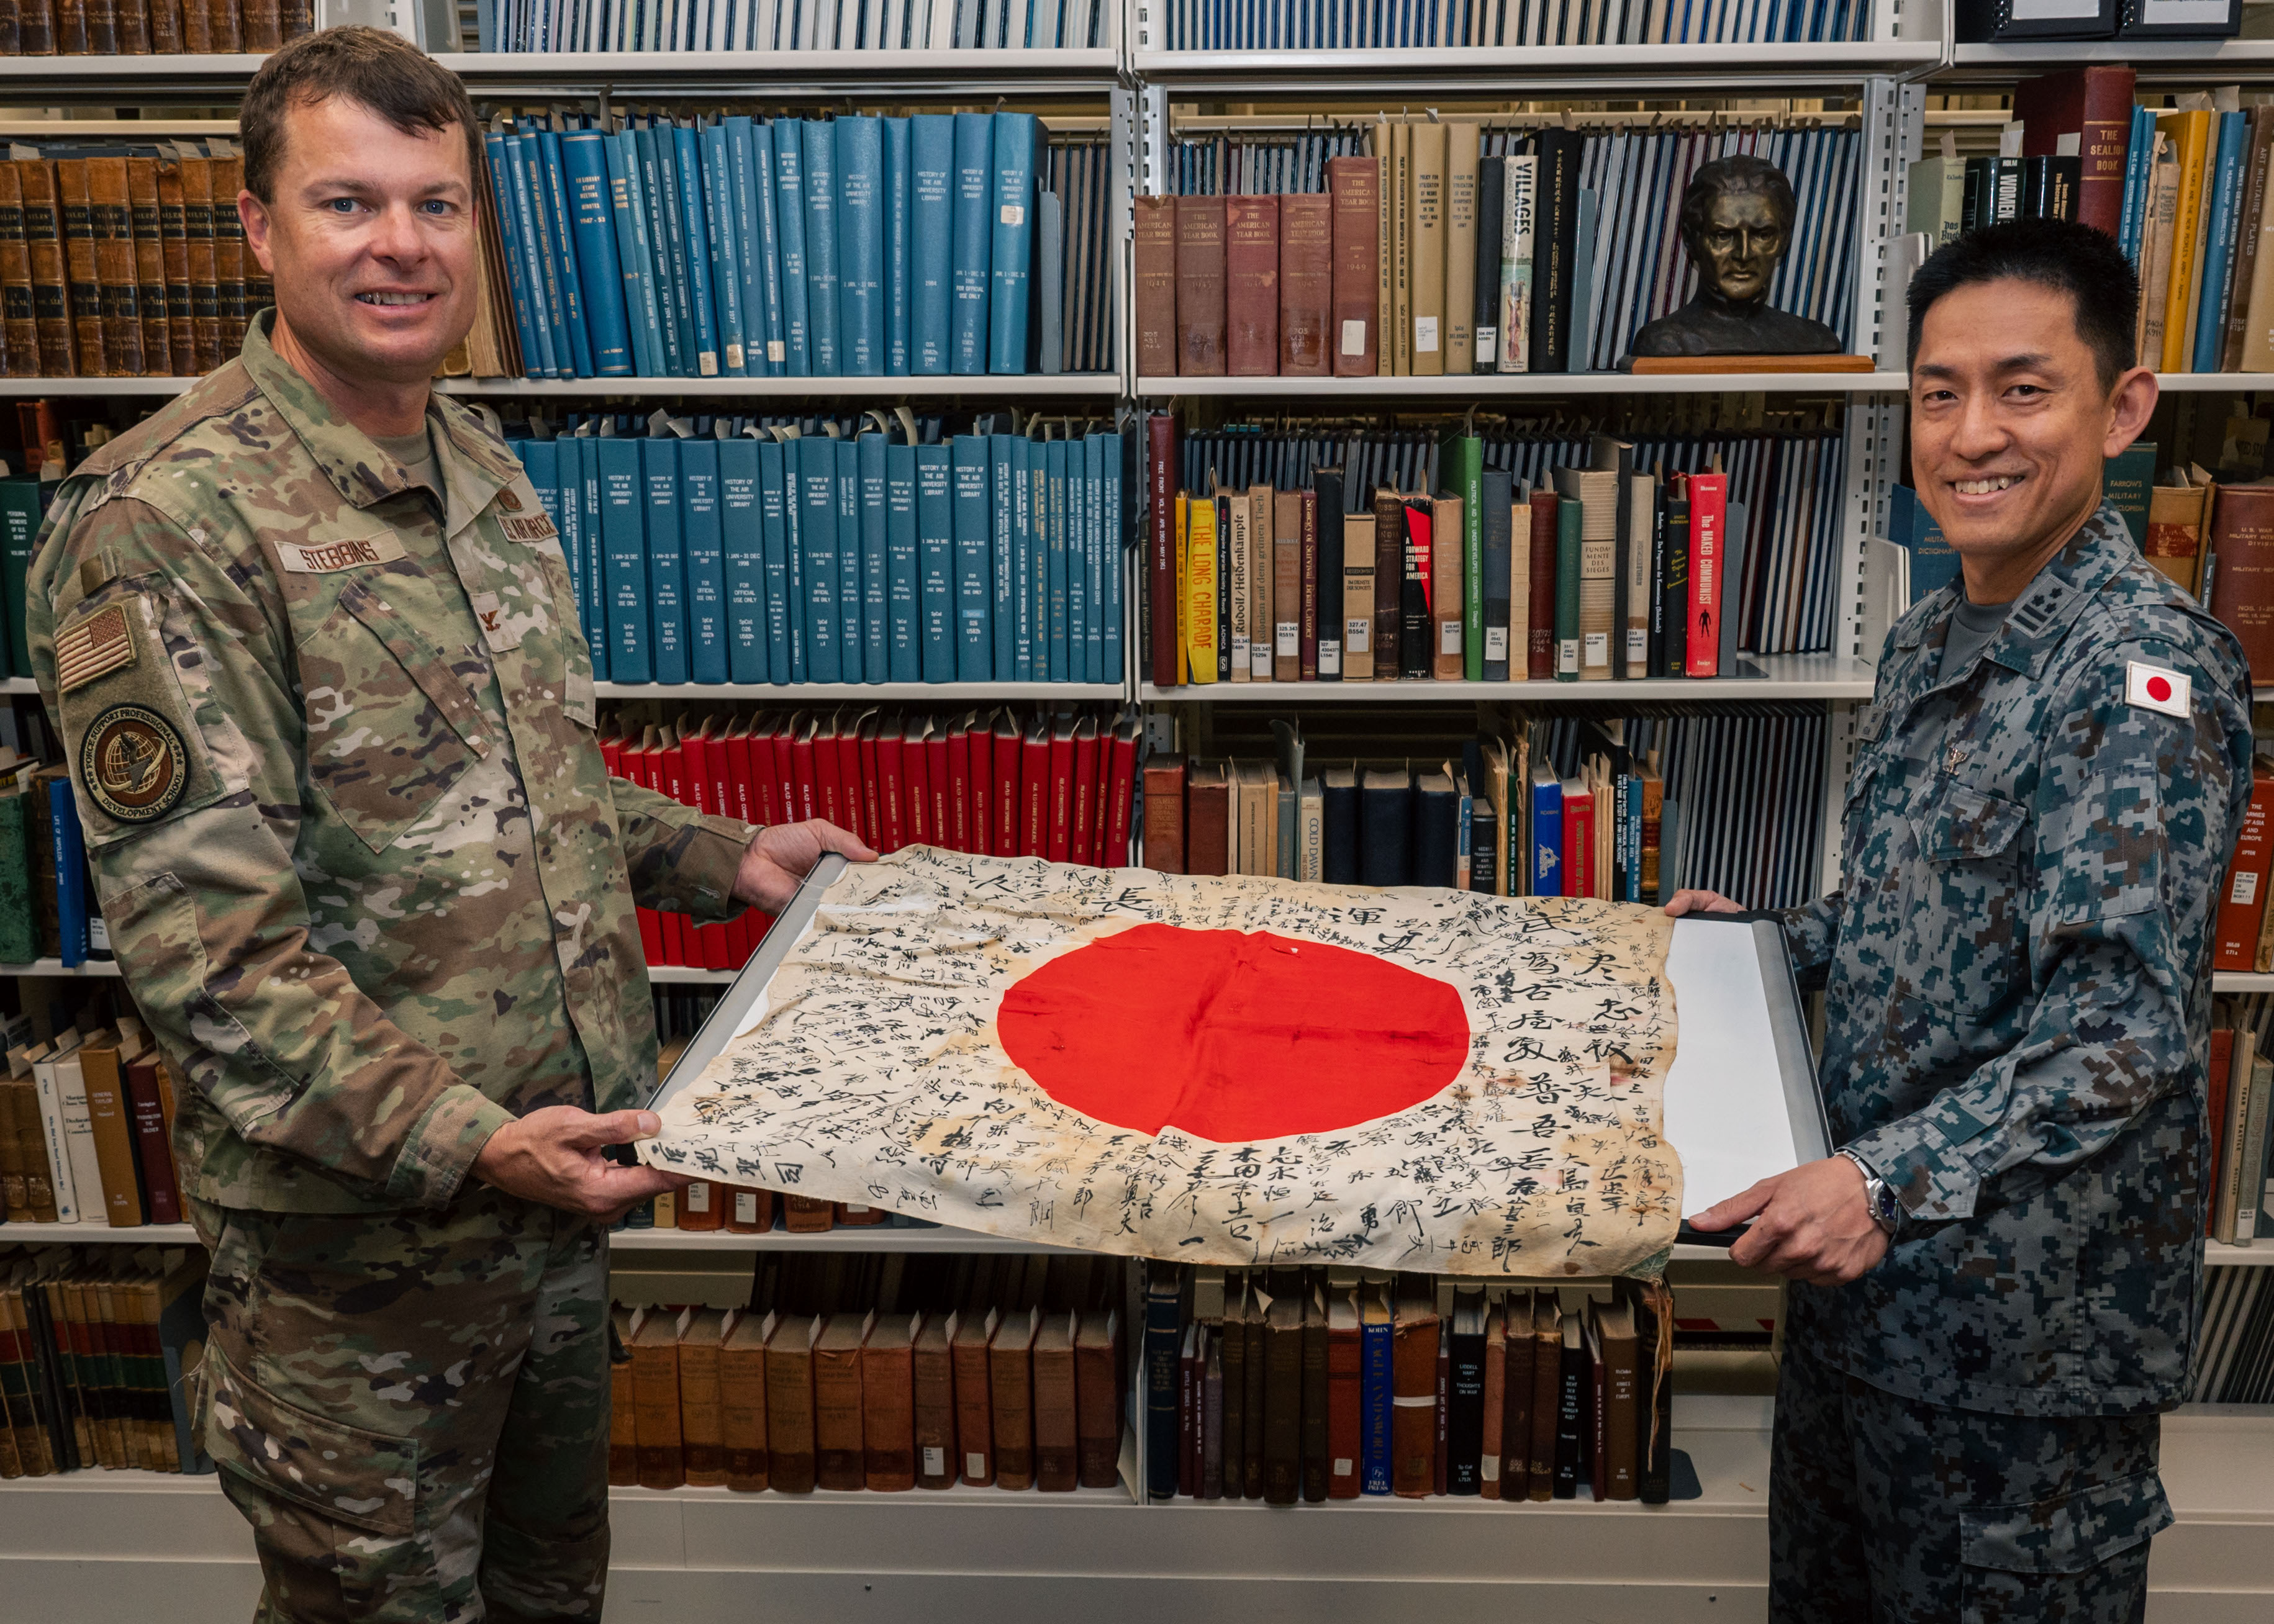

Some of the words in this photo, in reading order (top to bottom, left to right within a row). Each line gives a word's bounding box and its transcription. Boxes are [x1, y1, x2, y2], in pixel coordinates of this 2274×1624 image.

[2100, 130, 2118, 140] THE
[2096, 160, 2118, 171] BOOK
[1514, 162, 1533, 236] VILLAGES
[1998, 174, 2018, 219] WOMEN
[2252, 166, 2264, 214] MILITAIRE
[2247, 223, 2258, 256] PLATES
[1256, 495, 1264, 522] Tisch
[1701, 515, 1714, 528] The
[1194, 523, 1212, 547] THE
[1406, 537, 1410, 545] A
[1406, 546, 1429, 554] FORWARD
[1701, 531, 1713, 555] NAKED
[299, 541, 379, 571] STEBBINS
[1192, 554, 1212, 586] LONG
[1305, 545, 1314, 579] Survival
[1406, 572, 1428, 580] AMERICA
[1699, 559, 1713, 605] COMMUNIST
[1305, 584, 1314, 607] Brian
[1192, 592, 1212, 649] CHARADE
[86, 741, 94, 769] FORCE
[93, 711, 120, 741] SUPPORT
[120, 710, 176, 744] PROFESSIONAL
[102, 797, 163, 817] DEVELOPMENT
[163, 772, 184, 806] SCHOOL
[1309, 818, 1319, 846] COLD
[1309, 848, 1319, 880] DAWN
